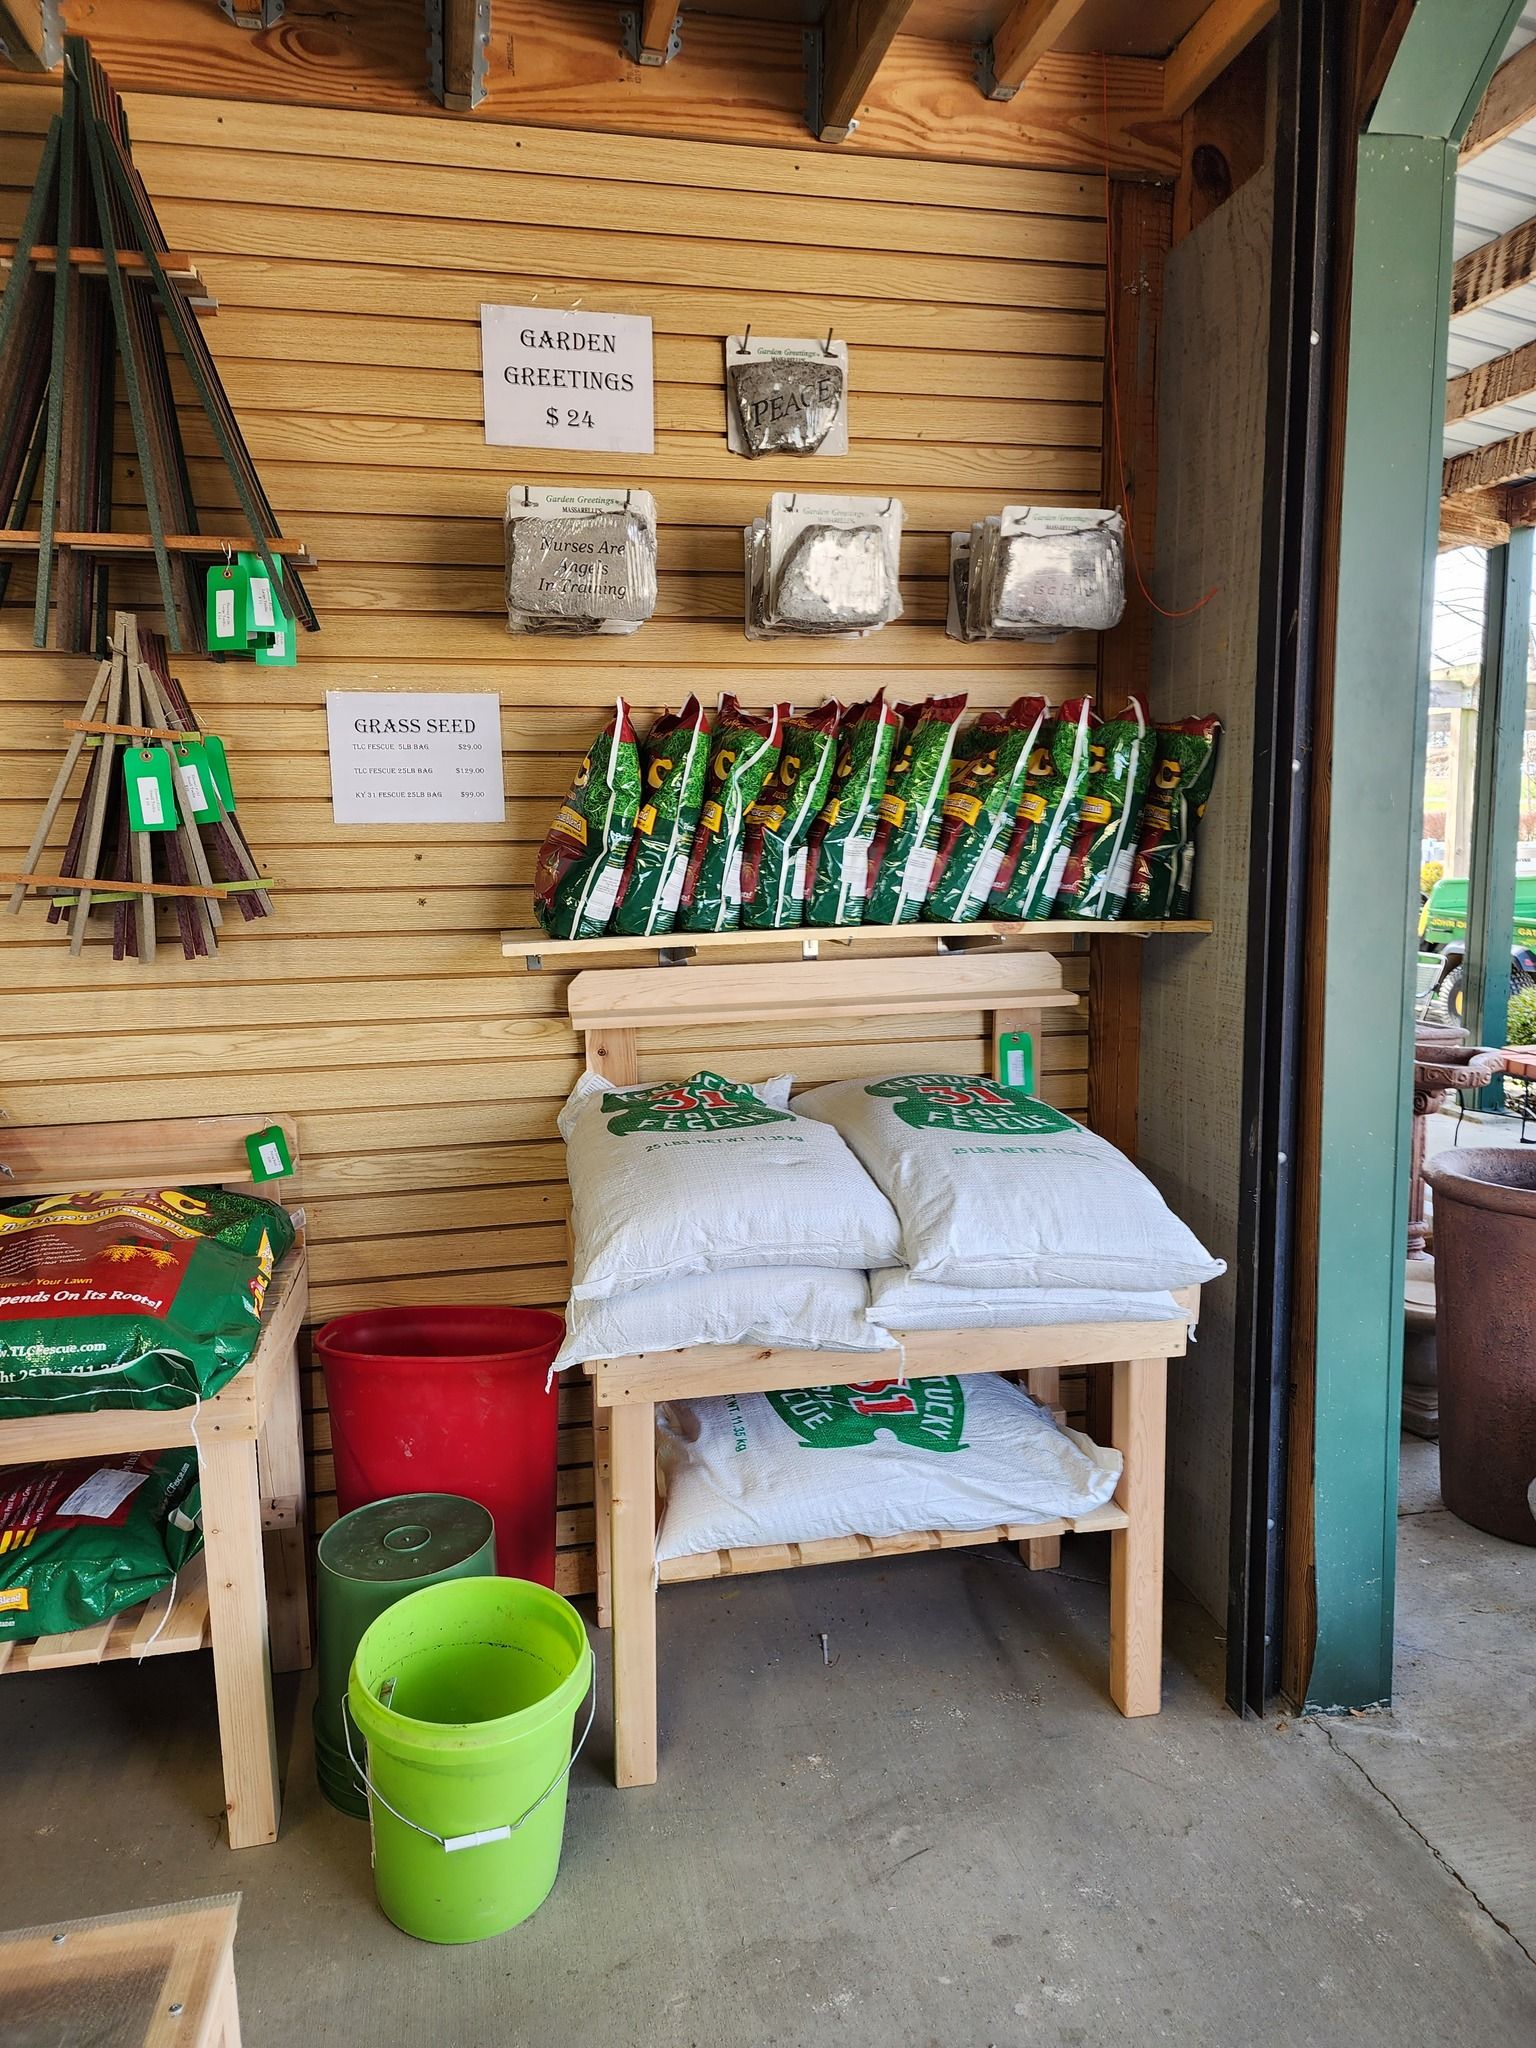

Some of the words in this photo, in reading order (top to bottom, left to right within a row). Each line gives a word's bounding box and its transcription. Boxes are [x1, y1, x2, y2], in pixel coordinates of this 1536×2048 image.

[520, 329, 616, 353] GARDEN
[757, 347, 782, 355] Garden
[504, 366, 634, 392] GREETINGS
[751, 378, 832, 428] PEACE
[546, 406, 559, 428] $
[567, 409, 595, 428] 24
[545, 495, 575, 503] Garden
[577, 496, 615, 505] Greetings
[540, 537, 595, 554] Nurses
[597, 541, 626, 555] Are
[560, 560, 609, 577] Angels
[538, 578, 557, 591] In
[561, 579, 626, 600] Training
[354, 718, 421, 734] GRASS
[426, 718, 476, 734] SEED
[367, 743, 395, 751] FESCUE
[878, 1074, 1010, 1091] KENTUCKY
[648, 1087, 739, 1112] 31
[918, 1086, 1016, 1106] 31
[636, 1111, 775, 1131] FESCUE
[666, 1109, 742, 1120] TALL
[928, 1110, 1057, 1130] FESCUE
[947, 1106, 1020, 1117] TALL
[645, 1143, 662, 1153] 25
[664, 1139, 695, 1147] LBS.
[697, 1137, 724, 1145] NET
[787, 1135, 804, 1143] kg
[111, 1205, 163, 1225] Fescue
[145, 1199, 185, 1220] BLEND
[36, 1278, 62, 1286] Your
[64, 1277, 94, 1285] Lawn
[53, 1290, 79, 1301] On
[82, 1289, 107, 1300] Its
[109, 1290, 163, 1310] Roots!
[19, 1369, 37, 1382] 25
[732, 1416, 746, 1436] 11.35
[735, 1439, 747, 1452] kg
